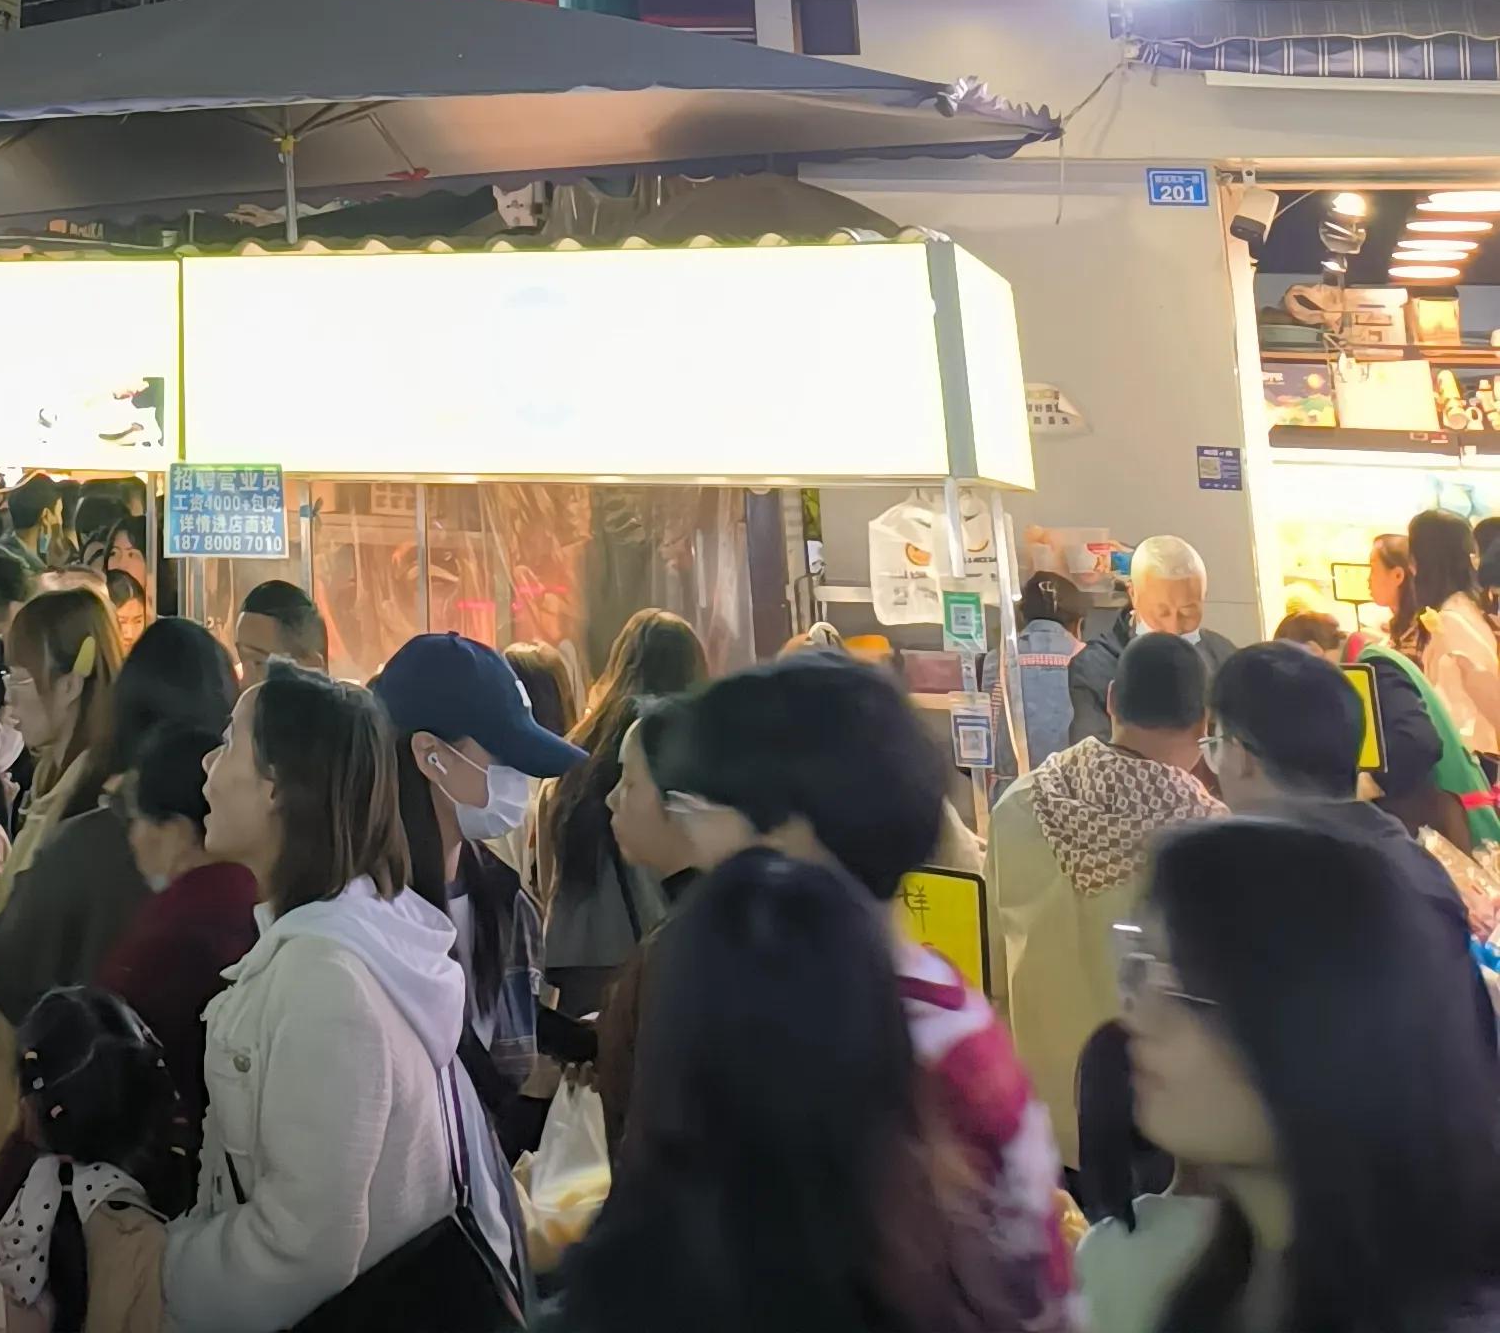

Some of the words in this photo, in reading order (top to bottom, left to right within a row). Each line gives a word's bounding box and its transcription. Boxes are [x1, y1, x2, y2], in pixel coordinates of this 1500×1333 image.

[1160, 185, 1195, 201] 201
[174, 468, 280, 493] 招聘营业员
